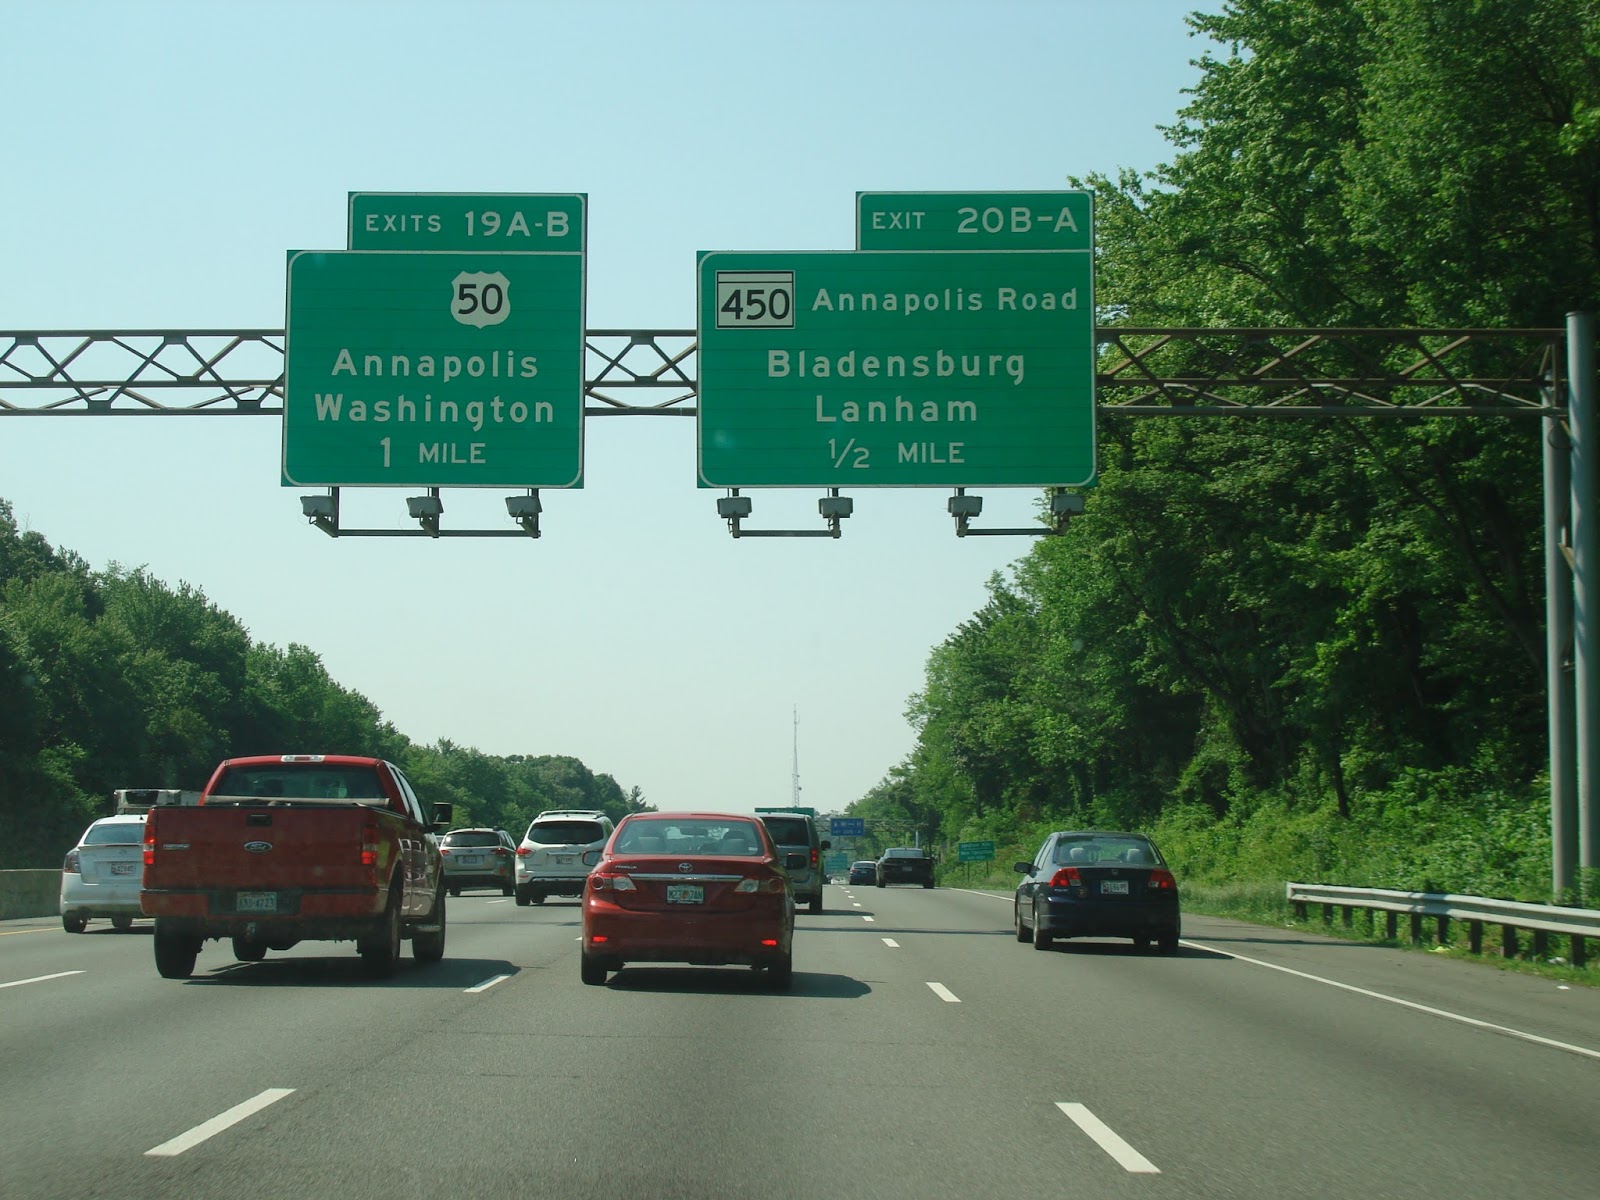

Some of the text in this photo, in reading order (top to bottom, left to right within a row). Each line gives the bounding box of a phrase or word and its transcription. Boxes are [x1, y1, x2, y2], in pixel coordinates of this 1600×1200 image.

[366, 211, 569, 236] EXITS 19A-B
[872, 207, 1078, 233] EXIT 20B-A
[458, 283, 503, 315] 50
[720, 289, 790, 320] 450
[812, 288, 1077, 316] Annapolis Road
[331, 349, 538, 383] Annapolis
[768, 350, 1024, 385] Bladensburg
[315, 394, 554, 432] Washington
[816, 395, 977, 422] Lanham
[380, 437, 486, 467] 1 MILE
[898, 443, 965, 464] MILE
